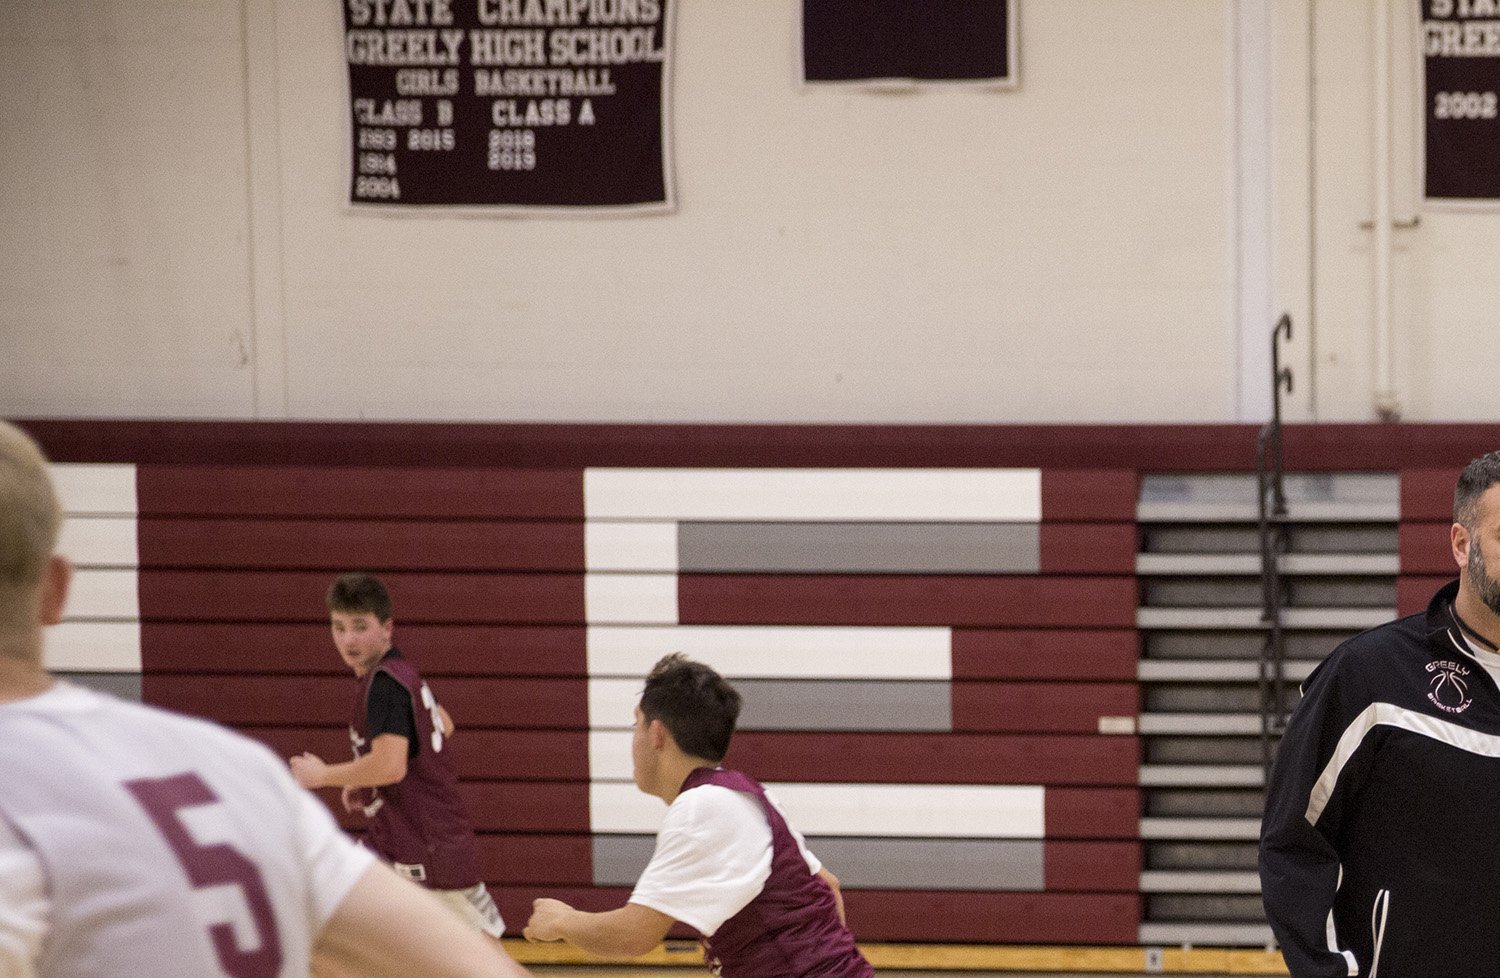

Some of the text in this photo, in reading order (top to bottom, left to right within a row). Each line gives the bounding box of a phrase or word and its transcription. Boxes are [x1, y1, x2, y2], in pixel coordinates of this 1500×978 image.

[351, 0, 454, 26] STATE
[347, 26, 665, 66] GREELY HIGH SCHOOL
[395, 67, 617, 96] GIRLS BASKETBALL
[353, 98, 424, 127] CLASS
[491, 98, 597, 127] CLASS A
[1434, 91, 1499, 120] 2002
[1425, 660, 1470, 676] GREELY
[1427, 692, 1473, 713] BASKETBALL
